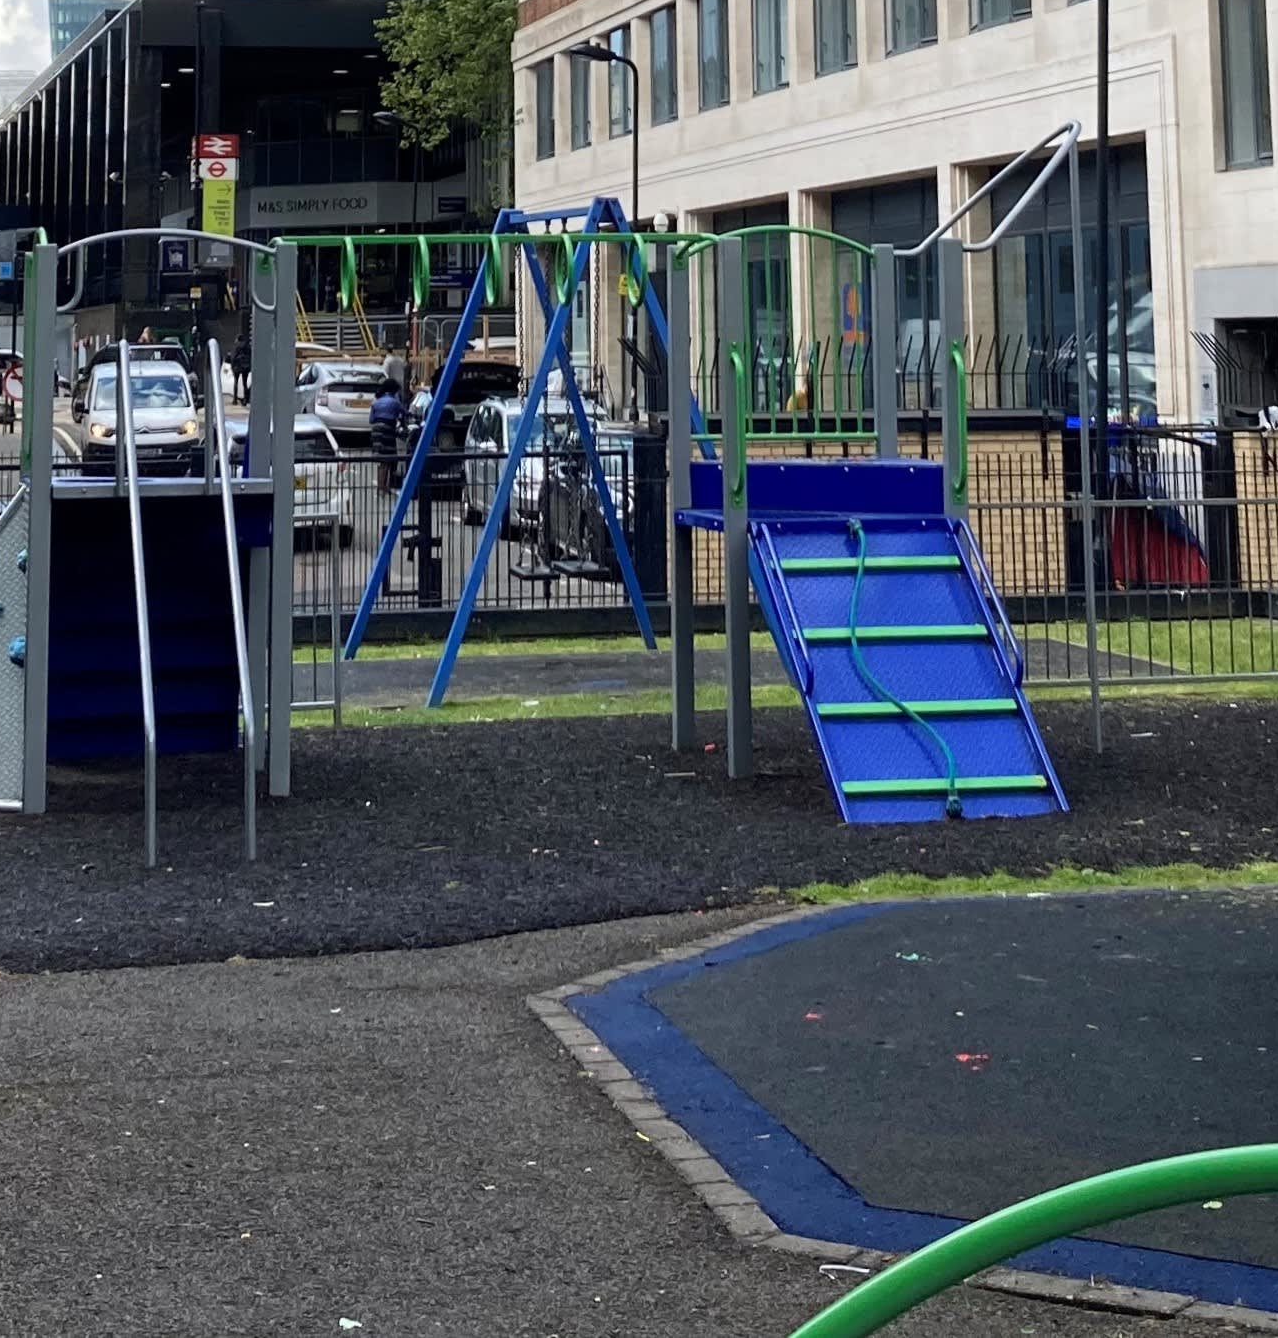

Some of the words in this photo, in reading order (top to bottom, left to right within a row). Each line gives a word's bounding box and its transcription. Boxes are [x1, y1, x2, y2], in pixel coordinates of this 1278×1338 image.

[257, 200, 282, 213] M&S
[286, 198, 329, 213] SIMPLY
[332, 196, 368, 211] FOOD
